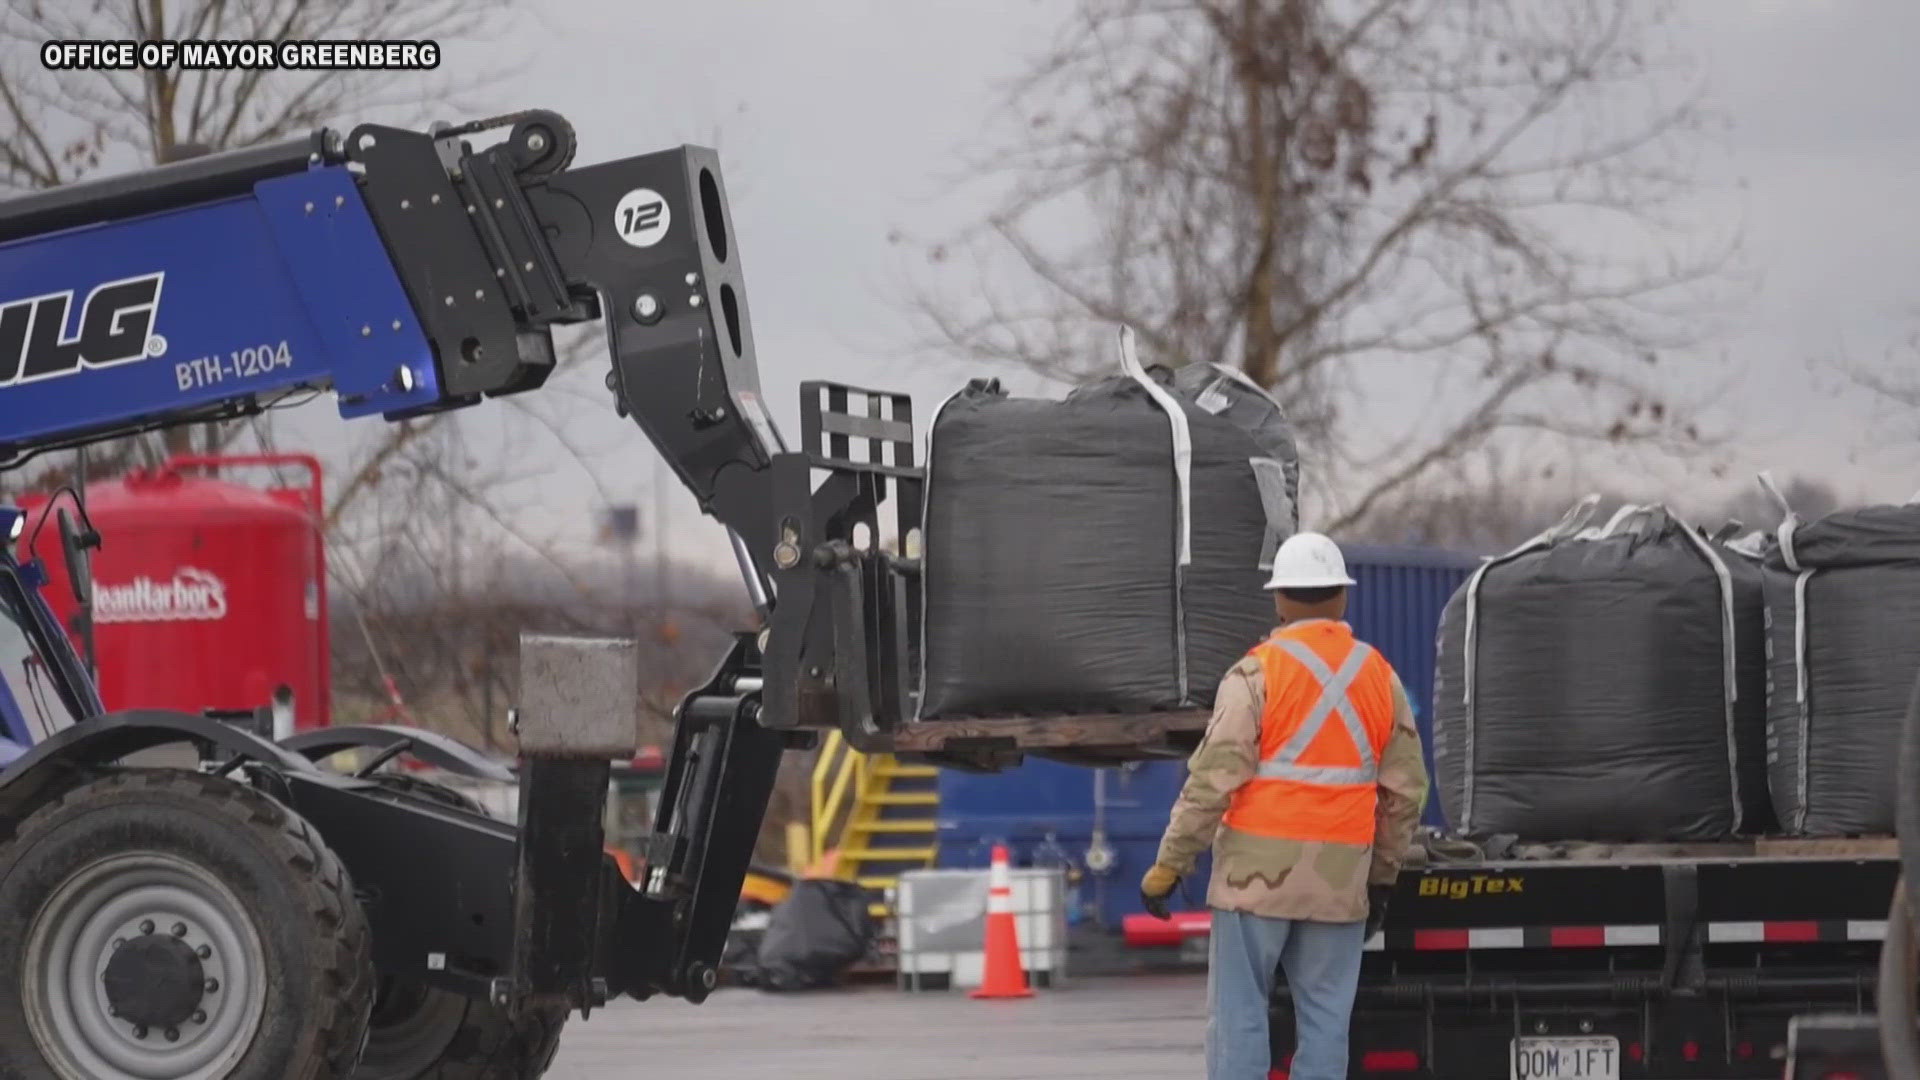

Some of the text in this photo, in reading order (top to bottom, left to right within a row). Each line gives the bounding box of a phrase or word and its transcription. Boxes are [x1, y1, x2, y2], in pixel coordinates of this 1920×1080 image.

[623, 200, 663, 235] 12
[175, 340, 292, 391] BTH-1204
[91, 567, 227, 622] leanHarbors
[1419, 875, 1524, 899] BigTex
